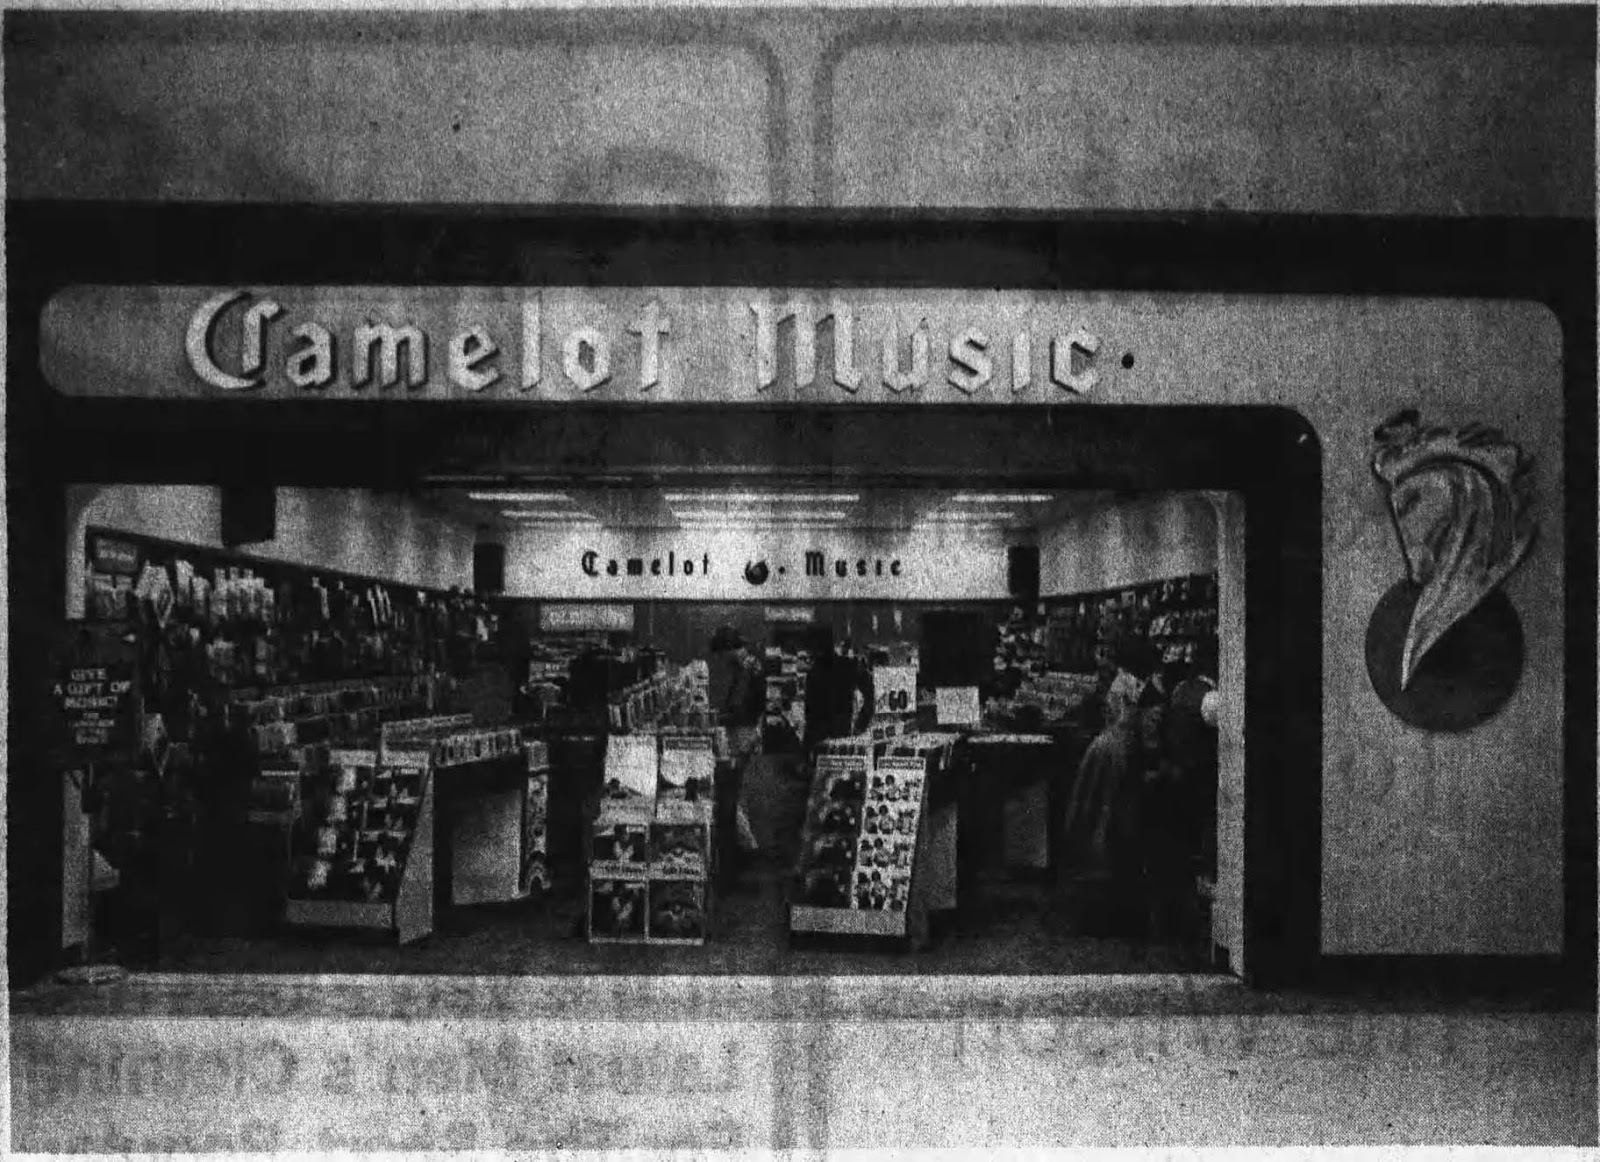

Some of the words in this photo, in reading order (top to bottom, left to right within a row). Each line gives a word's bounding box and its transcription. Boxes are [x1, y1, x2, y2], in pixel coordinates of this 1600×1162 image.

[186, 292, 672, 392] Camelot
[748, 300, 1100, 395] Music
[582, 551, 708, 576] Camelot
[805, 551, 901, 577] Music
